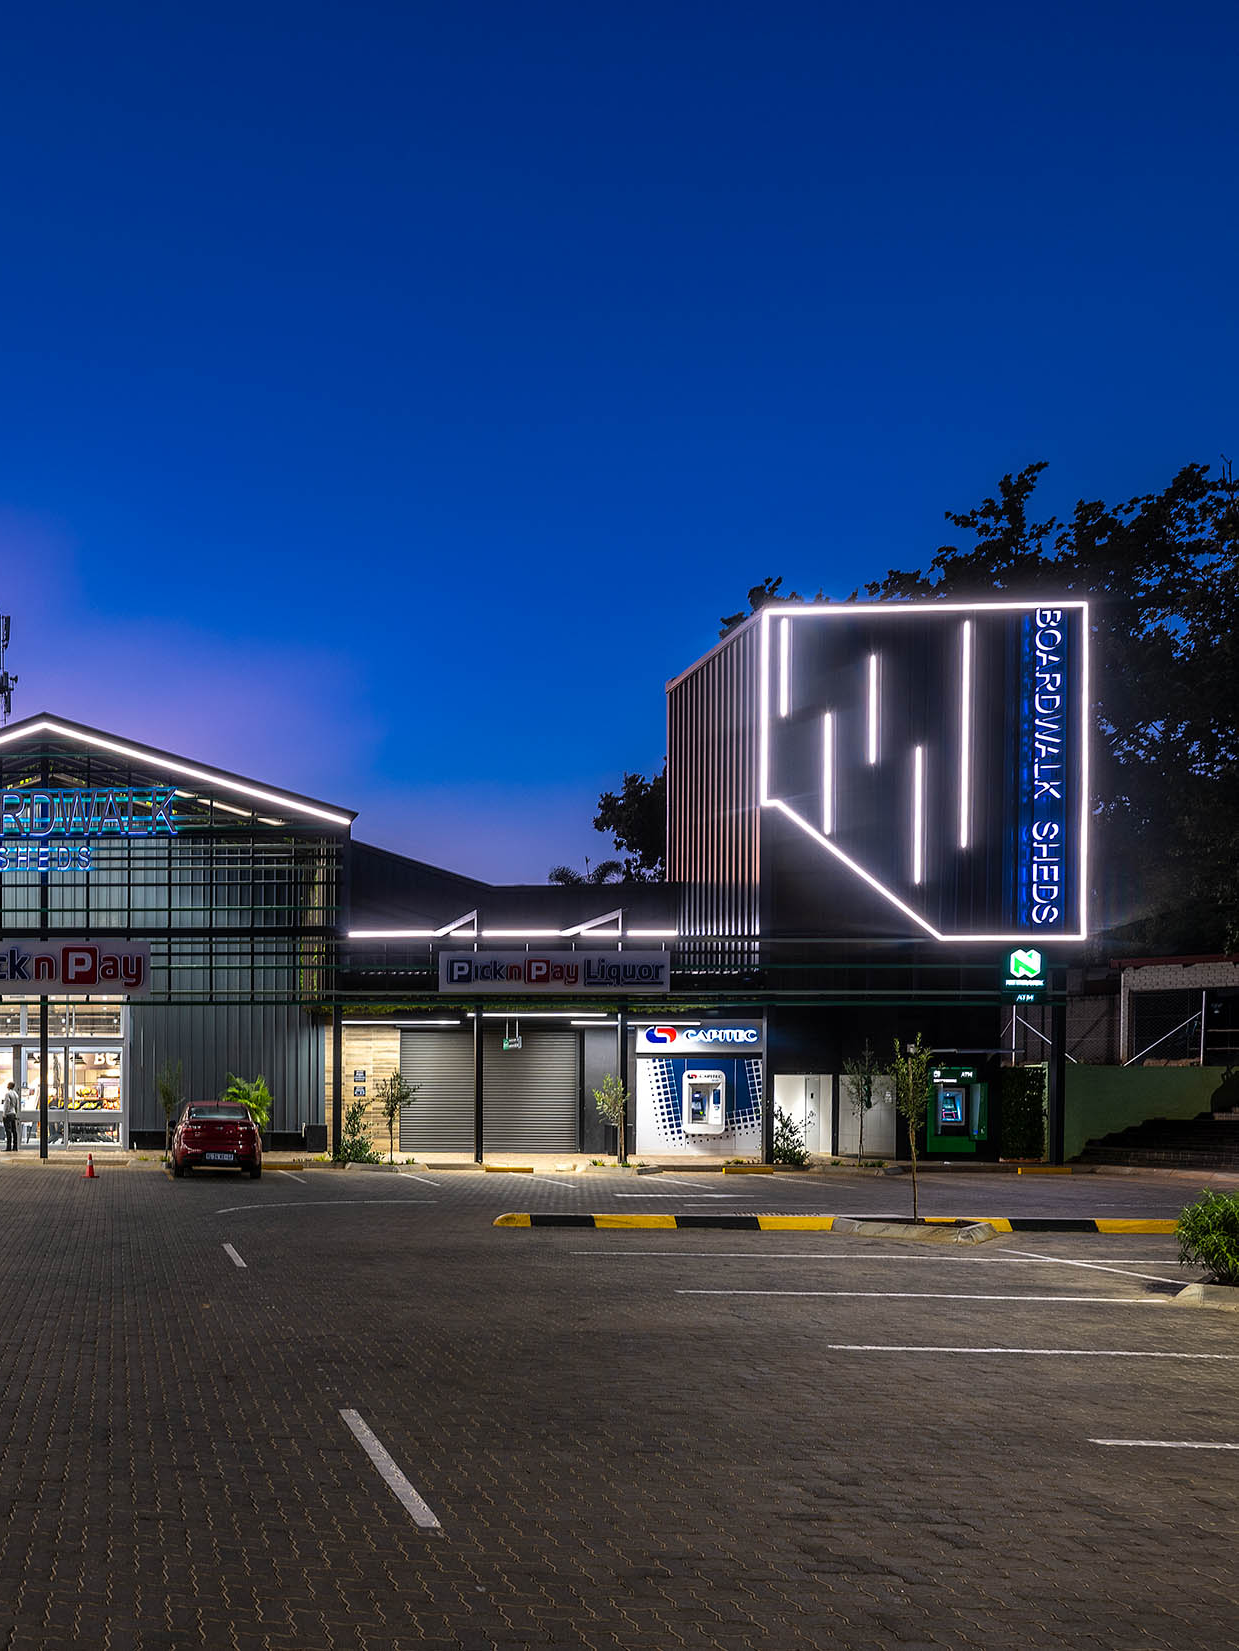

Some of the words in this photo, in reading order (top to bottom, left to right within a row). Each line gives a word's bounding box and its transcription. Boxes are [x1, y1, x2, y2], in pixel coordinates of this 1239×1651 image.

[1035, 608, 1062, 799] BOARDWALK
[1032, 821, 1060, 924] SHEDS
[584, 958, 665, 985] Liquor
[682, 1029, 758, 1043] CAPITEC
